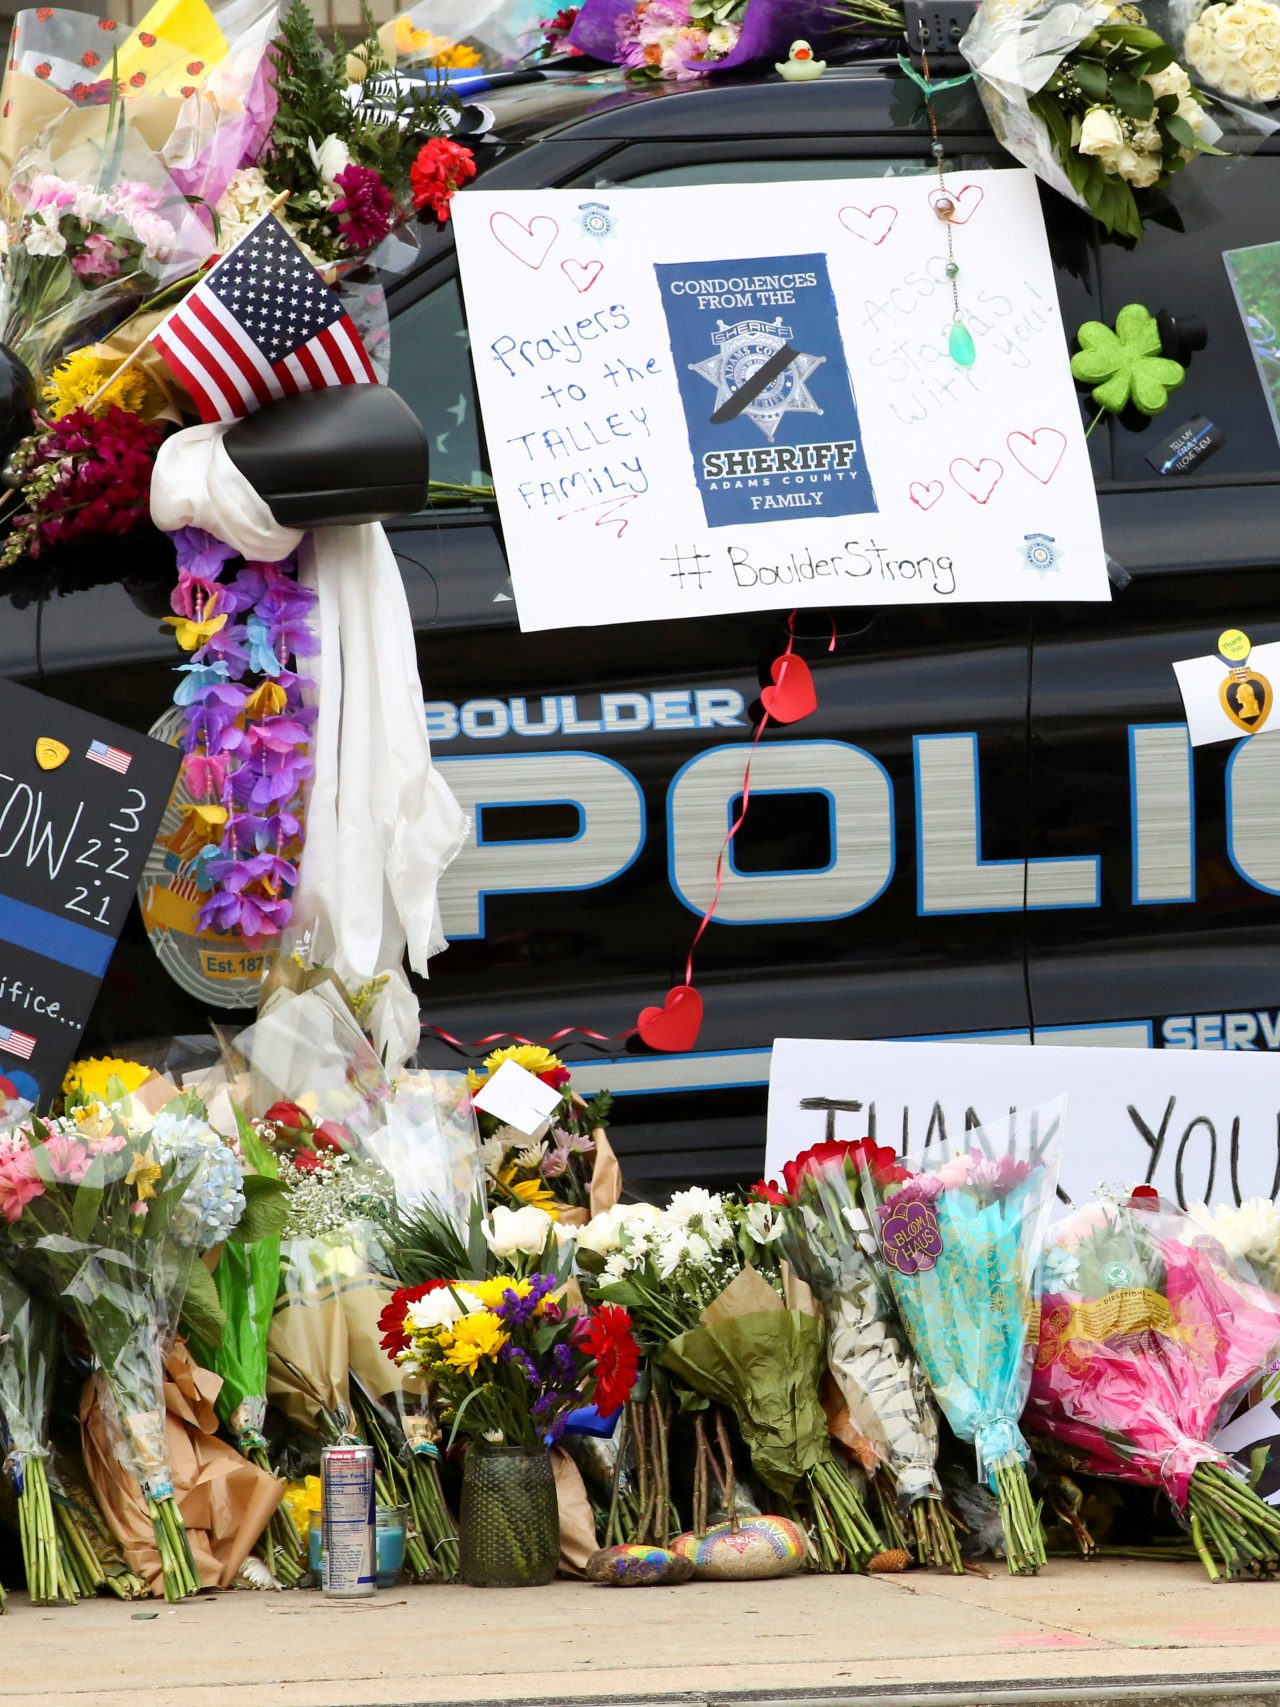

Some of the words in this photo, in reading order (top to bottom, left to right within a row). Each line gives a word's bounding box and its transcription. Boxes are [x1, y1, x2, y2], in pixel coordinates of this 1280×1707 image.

[671, 273, 817, 295] CONDOLENCES
[698, 293, 754, 310] FROM
[757, 290, 795, 305] THE
[490, 304, 630, 377] Prayers
[714, 322, 790, 343] SHERIFF
[725, 346, 751, 380] ADAMS
[541, 385, 587, 408] to
[603, 357, 663, 388] the
[507, 407, 651, 460] TALLEY
[1177, 436, 1198, 457] FAMILY
[1181, 429, 1192, 442] MY
[703, 440, 857, 480] SHERIFF
[1178, 450, 1196, 468] LOVE
[1194, 436, 1212, 454] THEM
[709, 477, 771, 491] ADAMS
[782, 470, 859, 486] COUNTY
[750, 491, 824, 511] FAMILY
[424, 688, 747, 740] BOULDER
[207, 957, 237, 973] Est.
[894, 1216, 927, 1247] BLOOM
[902, 1229, 935, 1262] HAUS
[725, 1535, 759, 1545] ERIC
[739, 1520, 788, 1546] LOVE
